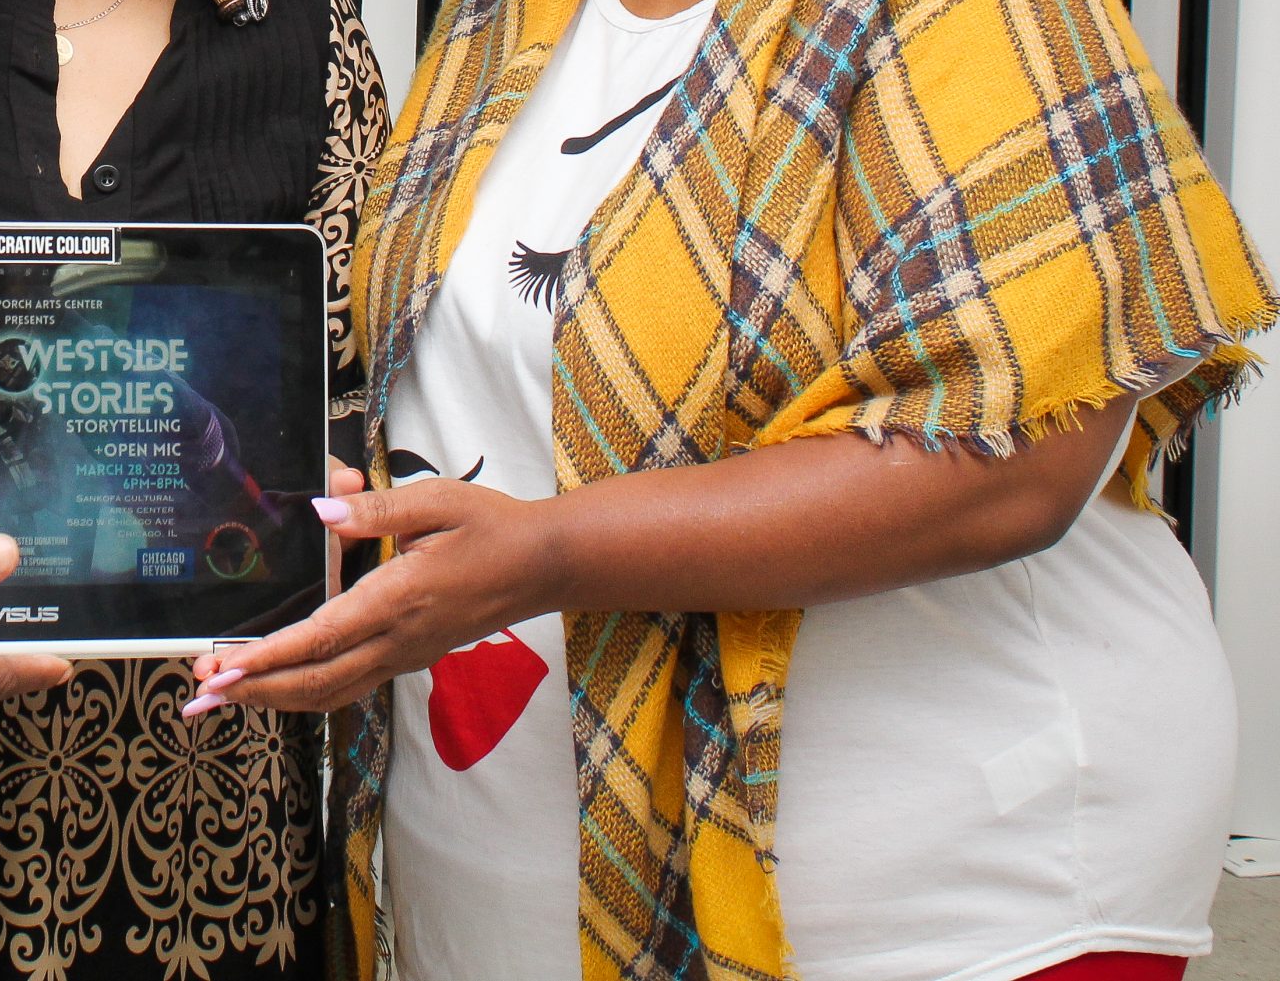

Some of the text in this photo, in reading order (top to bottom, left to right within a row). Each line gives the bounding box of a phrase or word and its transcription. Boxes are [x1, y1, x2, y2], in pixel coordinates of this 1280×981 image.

[56, 236, 110, 255] COLOUR
[35, 299, 62, 310] ARTS
[64, 299, 103, 310] CENTER
[4, 315, 56, 325] PRESENTS
[17, 338, 189, 372] WESTSIDE
[32, 381, 174, 414] STORIES
[66, 419, 181, 433] STORYTELLING
[153, 442, 182, 457] MIC
[75, 463, 180, 477] MARCH 28, 2023
[142, 551, 185, 565] CHICAGO
[142, 564, 180, 577] BEYOND
